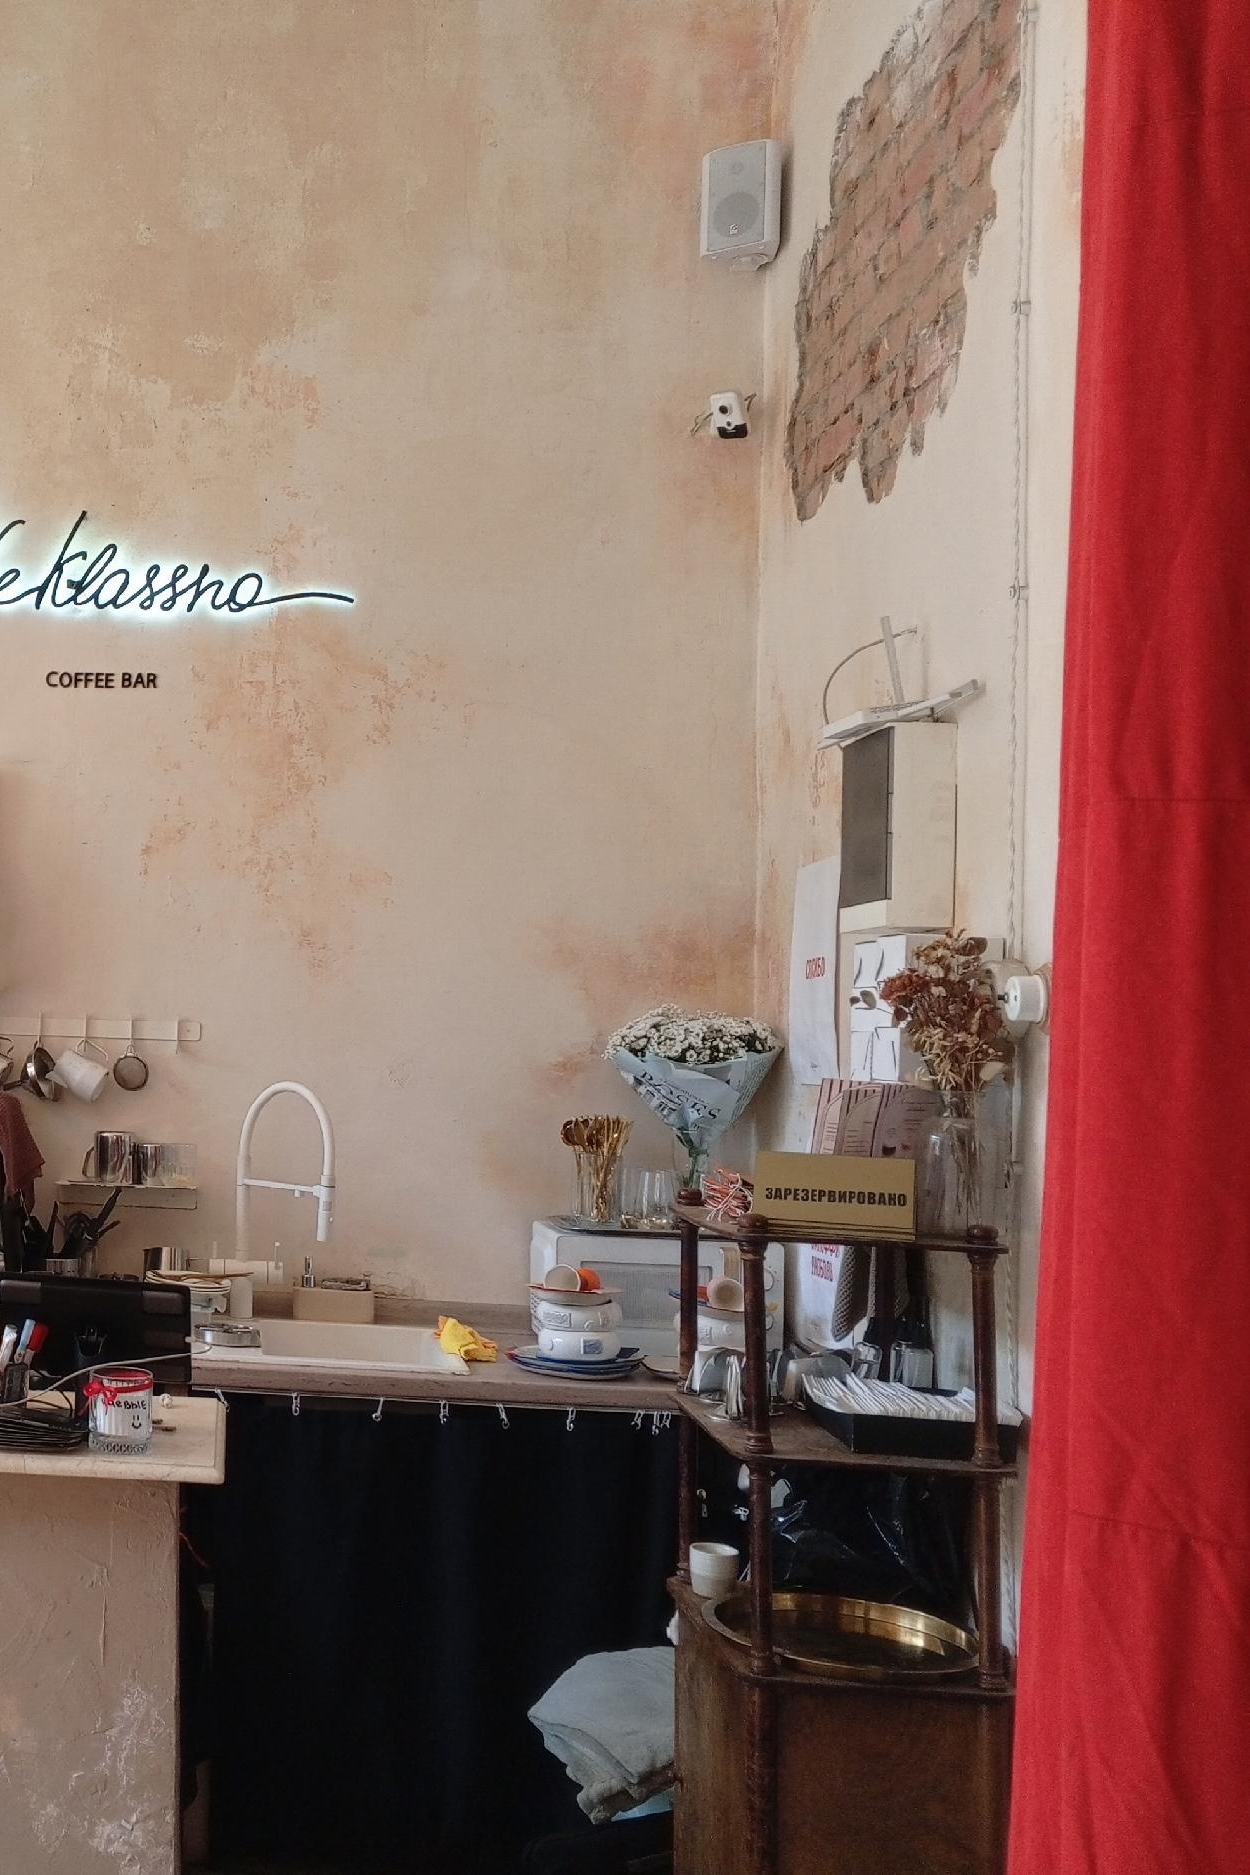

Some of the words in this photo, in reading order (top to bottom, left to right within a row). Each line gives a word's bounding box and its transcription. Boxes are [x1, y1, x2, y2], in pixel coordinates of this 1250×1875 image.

[46, 671, 115, 689] COFFEE
[120, 671, 158, 689] BAR
[765, 1186, 908, 1208] ЗАРЕЗЕРВИРОВАНО
